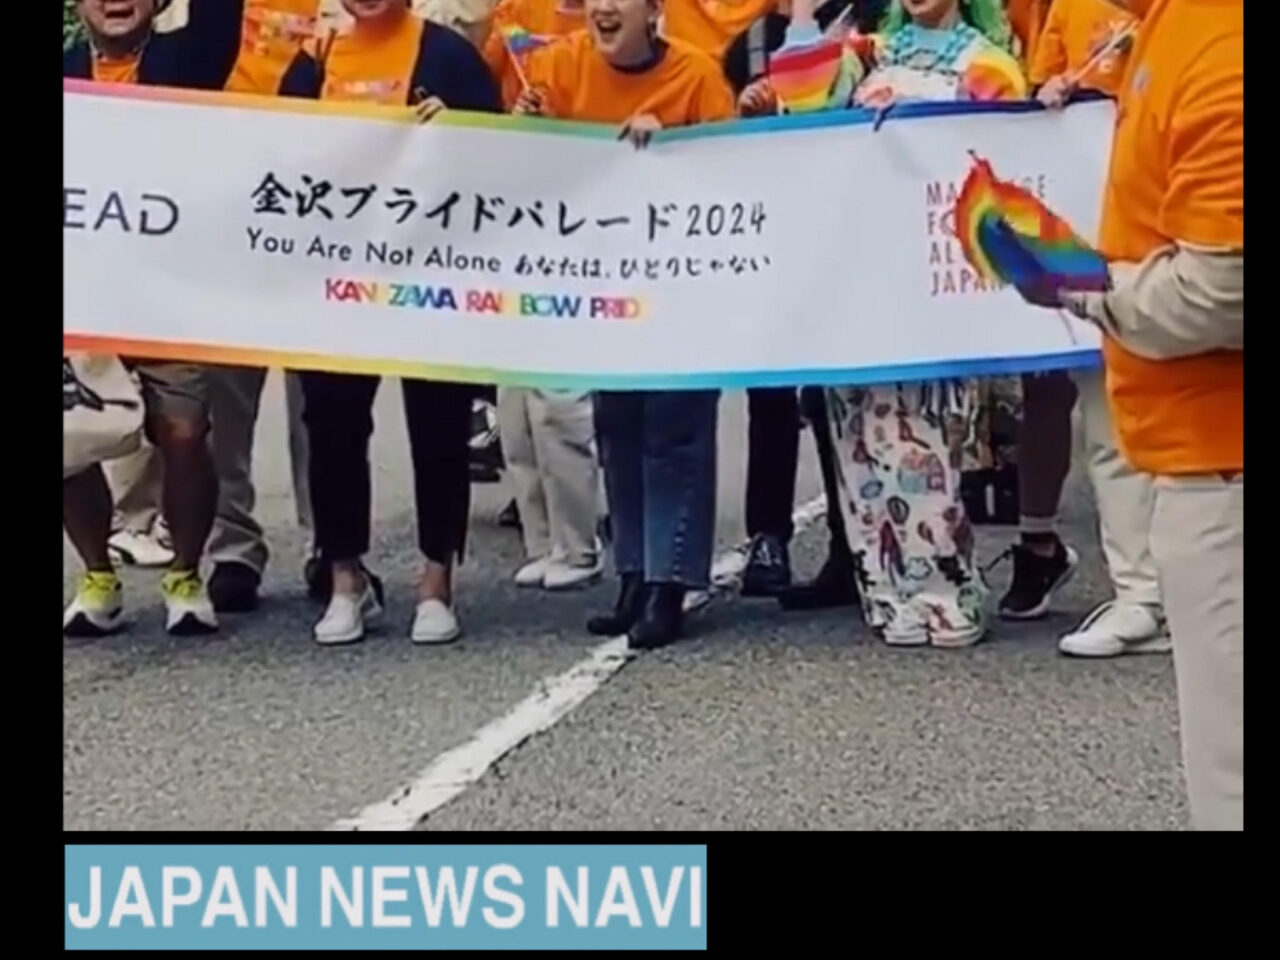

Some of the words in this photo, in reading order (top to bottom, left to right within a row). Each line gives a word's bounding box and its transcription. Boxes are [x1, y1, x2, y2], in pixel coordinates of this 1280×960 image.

[246, 227, 294, 254] You
[306, 235, 352, 262] Are
[365, 241, 413, 266] Not
[424, 244, 501, 274] Alone
[466, 289, 581, 319] RAIBOW
[590, 297, 652, 320] PRID
